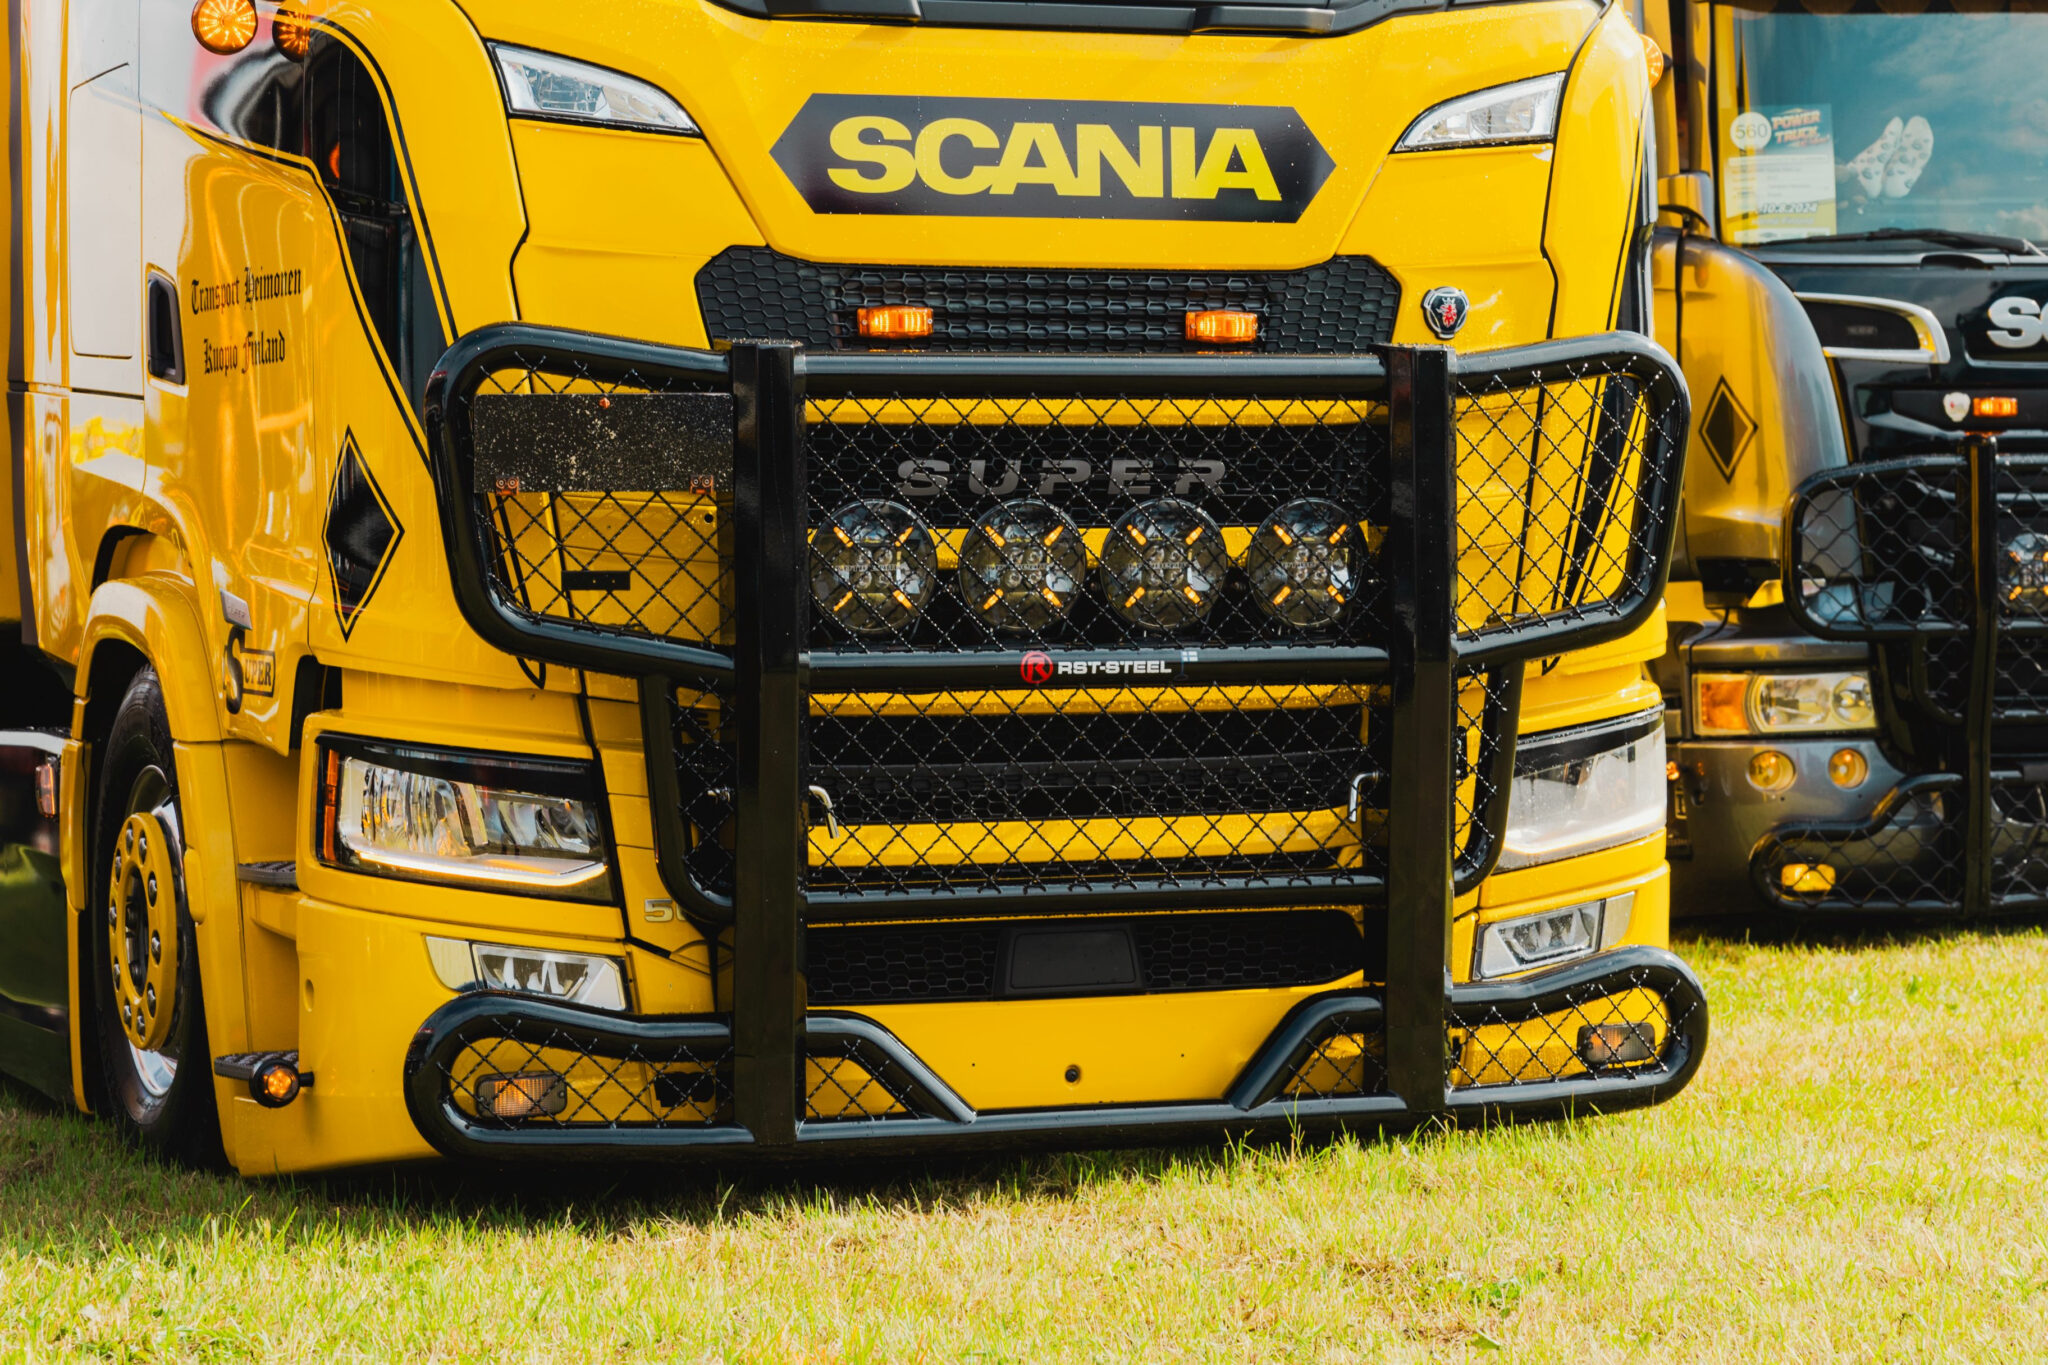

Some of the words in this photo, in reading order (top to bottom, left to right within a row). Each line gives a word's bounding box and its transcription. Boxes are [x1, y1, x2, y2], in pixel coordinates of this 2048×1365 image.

[1734, 124, 1768, 139] 560
[1772, 110, 1821, 130] POWER
[1775, 126, 1818, 144] TRUCK
[827, 115, 1283, 201] SCANIA
[191, 278, 240, 315] Transport
[1987, 296, 2048, 348] S
[204, 337, 238, 376] Kuopio
[241, 330, 286, 374] Finland
[898, 459, 1226, 496] SUPER
[1057, 660, 1172, 675] RST-STEEL
